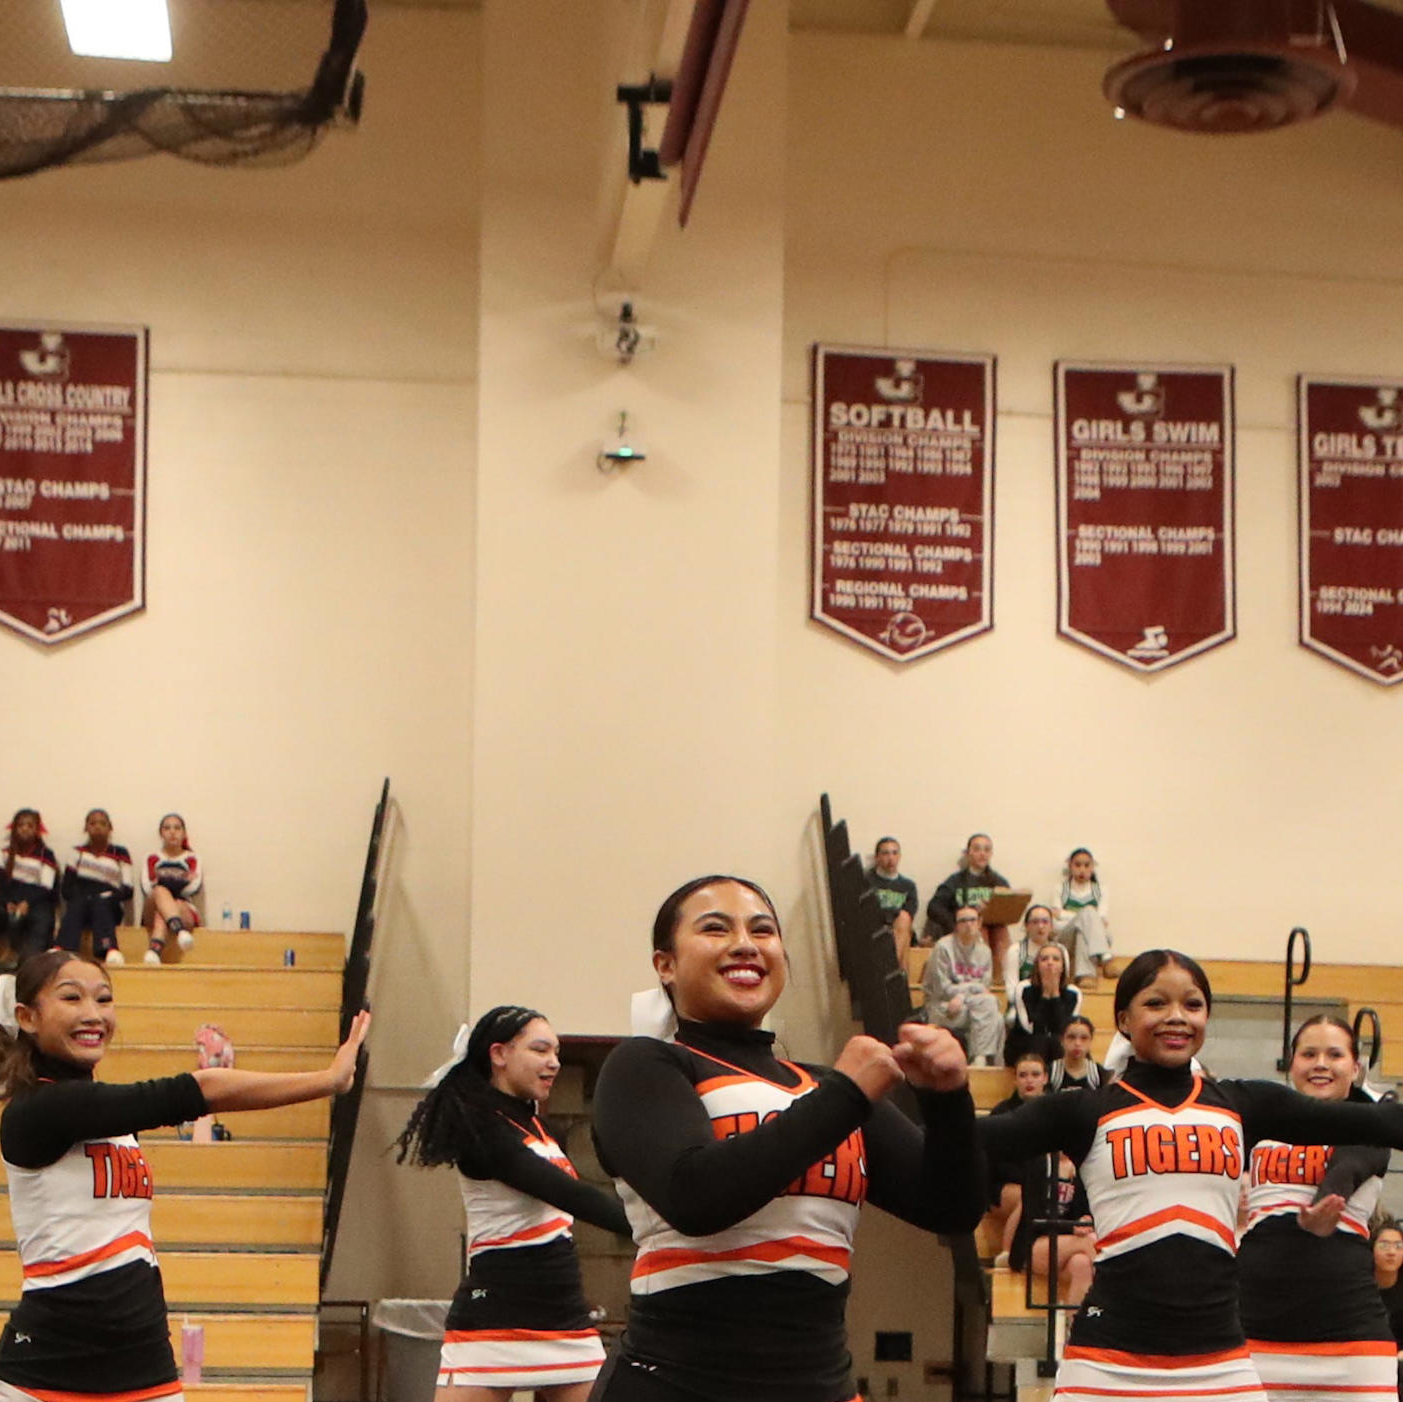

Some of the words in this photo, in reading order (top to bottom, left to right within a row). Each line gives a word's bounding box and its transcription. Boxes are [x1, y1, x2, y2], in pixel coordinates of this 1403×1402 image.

[16, 380, 63, 409] CROSS
[65, 382, 130, 411] COUNTRY
[829, 402, 981, 433] SOFTBALL
[838, 430, 903, 446] DIVISION
[907, 433, 972, 450] CHAMPS
[1072, 418, 1146, 442] GIRLS
[1151, 420, 1220, 444] SWIM
[1313, 431, 1377, 459] GIRLS
[1080, 448, 1146, 462] DIVISION
[1149, 449, 1213, 464] CHAMPS
[1323, 460, 1386, 477] DIVISION
[39, 480, 110, 501] CHAMPS
[849, 502, 889, 519] STAC
[893, 504, 960, 523] CHAMPS
[61, 522, 124, 542] CHAMPS
[1078, 524, 1155, 540] SECTIONAL
[1157, 525, 1215, 542] CHAMPS
[1333, 527, 1373, 546] STAC
[833, 540, 910, 558] SECTIONAL
[913, 543, 973, 562] CHAMPS
[836, 579, 906, 597] REGIONAL
[909, 583, 969, 601] CHAMPS
[1319, 585, 1394, 604] SECTIONAL
[1106, 1124, 1241, 1180] TIGERS
[85, 1143, 153, 1199] TIGE
[1251, 1145, 1335, 1187] TIGER
